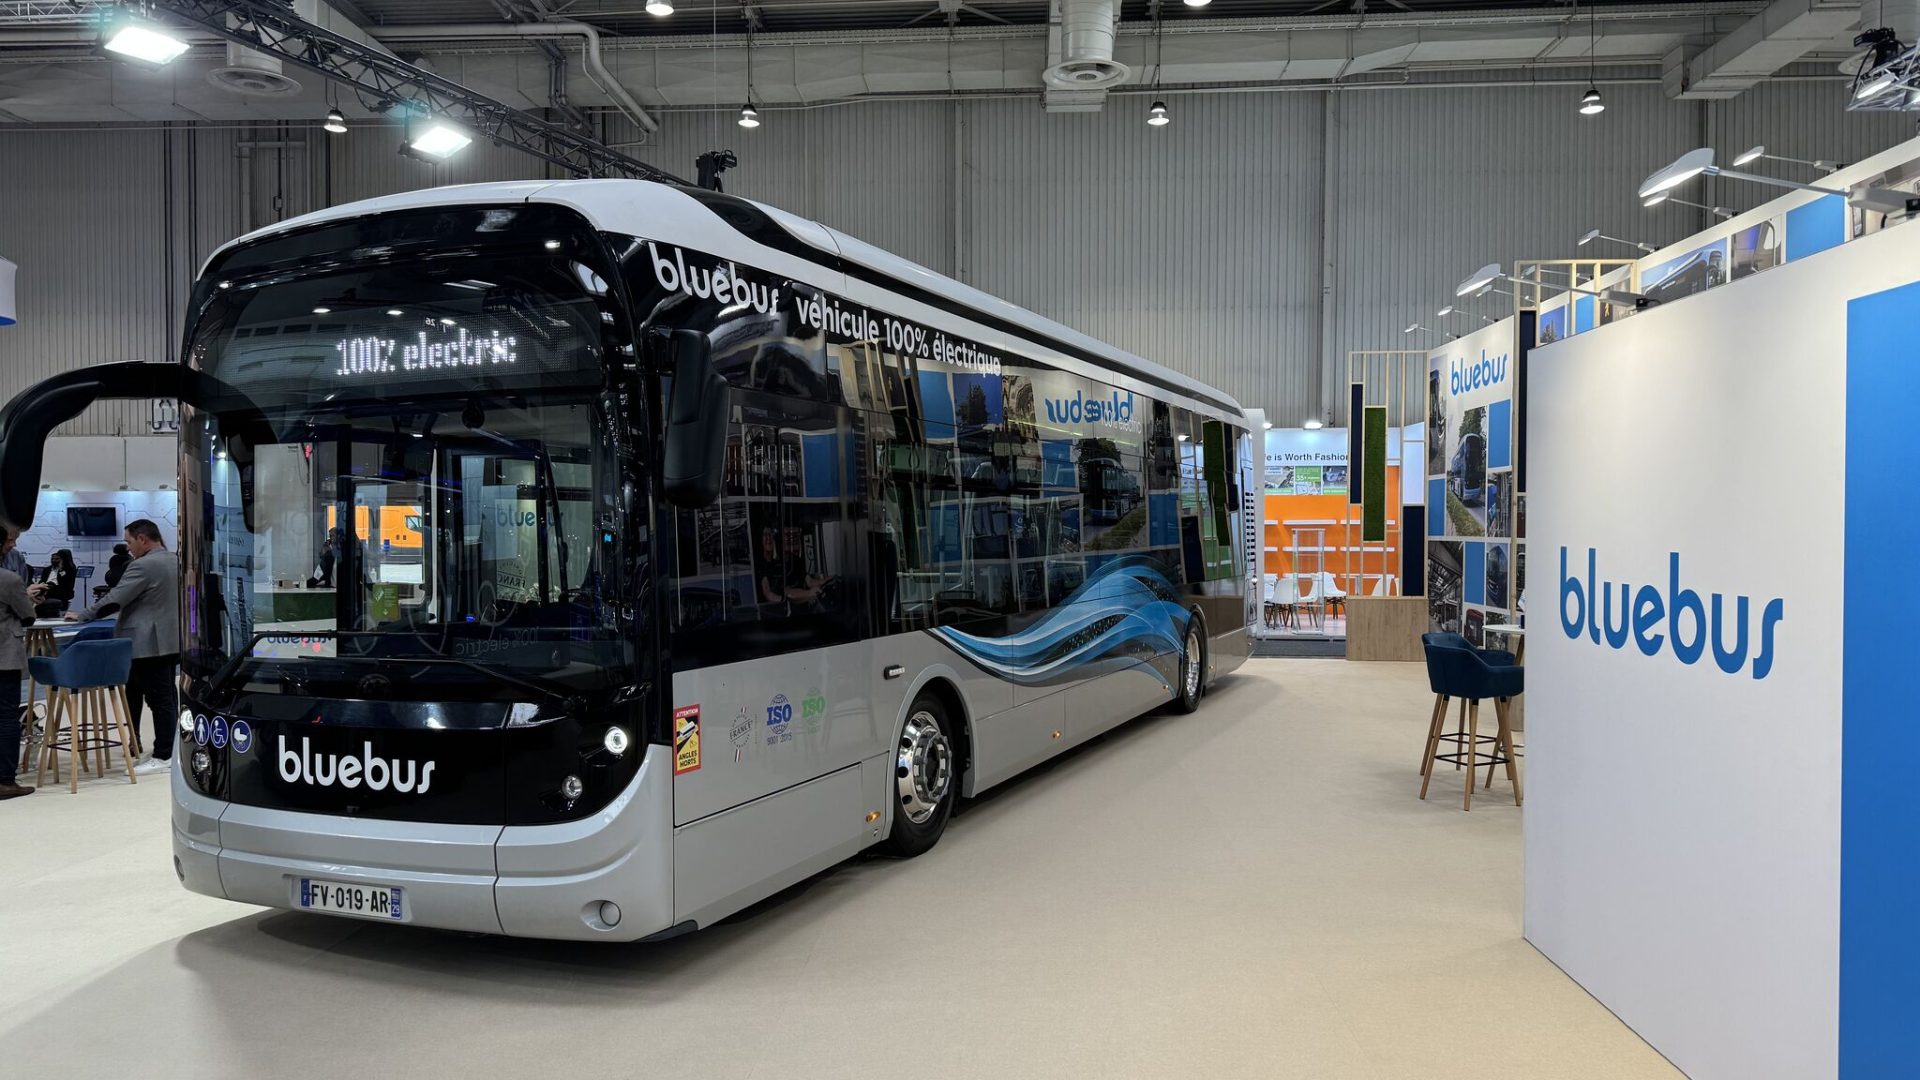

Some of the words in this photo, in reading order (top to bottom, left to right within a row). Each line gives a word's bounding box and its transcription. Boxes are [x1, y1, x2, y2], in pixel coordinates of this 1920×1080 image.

[648, 242, 779, 316] bluebus
[336, 336, 396, 376] 100%
[403, 327, 517, 371] electric
[796, 293, 879, 344] véhicule
[883, 317, 929, 358] 100%
[933, 332, 1001, 377] électrique
[1451, 349, 1508, 396] bluebus
[1274, 453, 1282, 461] is
[1284, 453, 1312, 461] Worth
[1560, 546, 1784, 680] bluebus
[767, 704, 792, 726] ISO
[802, 696, 826, 718] ISO
[278, 734, 436, 795] bluebus
[679, 750, 697, 760] ANGLES
[680, 758, 696, 767] MORTS
[310, 884, 389, 914] FV-019-AR
